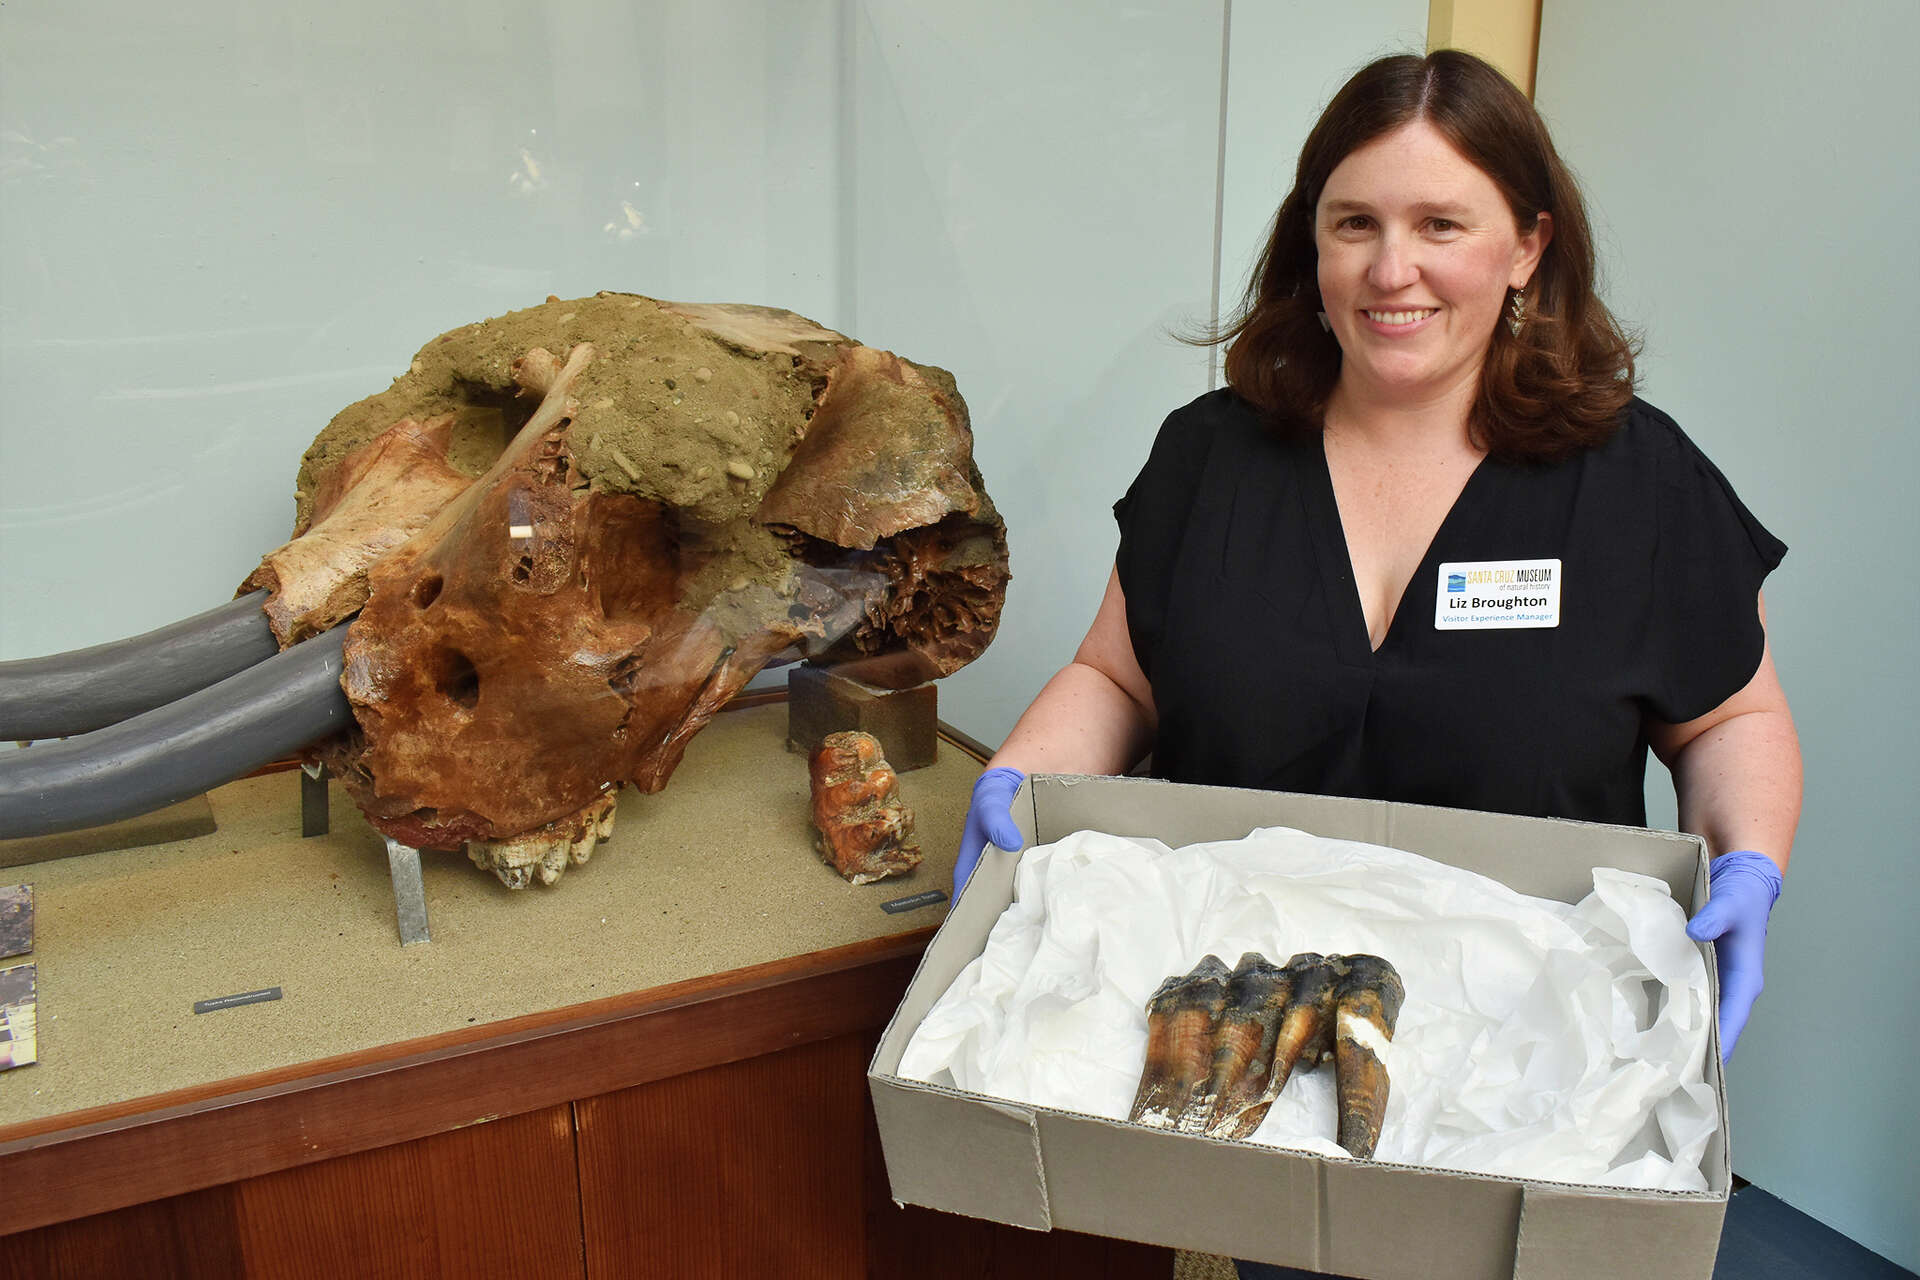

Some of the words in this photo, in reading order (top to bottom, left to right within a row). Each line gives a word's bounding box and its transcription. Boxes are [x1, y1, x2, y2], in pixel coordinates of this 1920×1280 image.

[1467, 570, 1493, 584] SANTA
[1494, 570, 1515, 583] CRUZ
[1516, 569, 1552, 583] MUSEUM
[1506, 583, 1529, 591] natural
[1529, 582, 1551, 591] history
[1449, 597, 1467, 609] Liz
[1472, 596, 1547, 609] Broughton
[1442, 614, 1469, 623] Visitor
[1470, 614, 1515, 623] Experience
[1516, 613, 1553, 622] Manager
